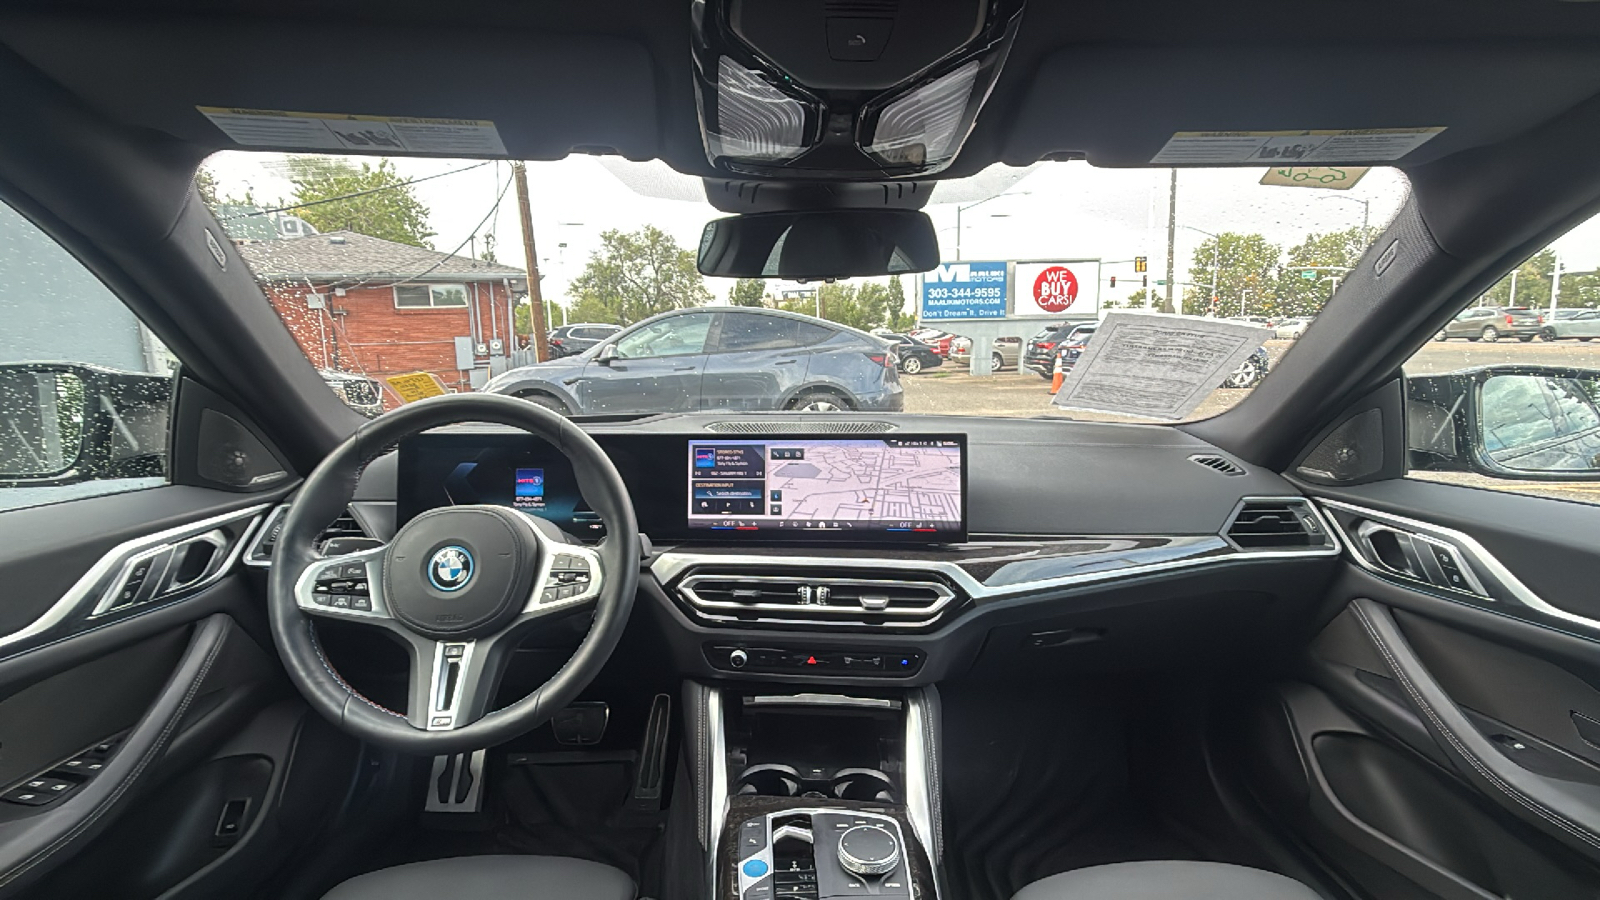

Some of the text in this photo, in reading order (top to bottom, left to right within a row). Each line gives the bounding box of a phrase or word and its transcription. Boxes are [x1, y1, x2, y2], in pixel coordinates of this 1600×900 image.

[1046, 270, 1067, 282] WE
[928, 287, 1001, 299] 303-344-9595
[1041, 281, 1072, 296] BUY
[1038, 295, 1073, 306] CARS!
[923, 309, 942, 317] Don't
[944, 309, 968, 317] Dream
[979, 308, 998, 316] Drive
